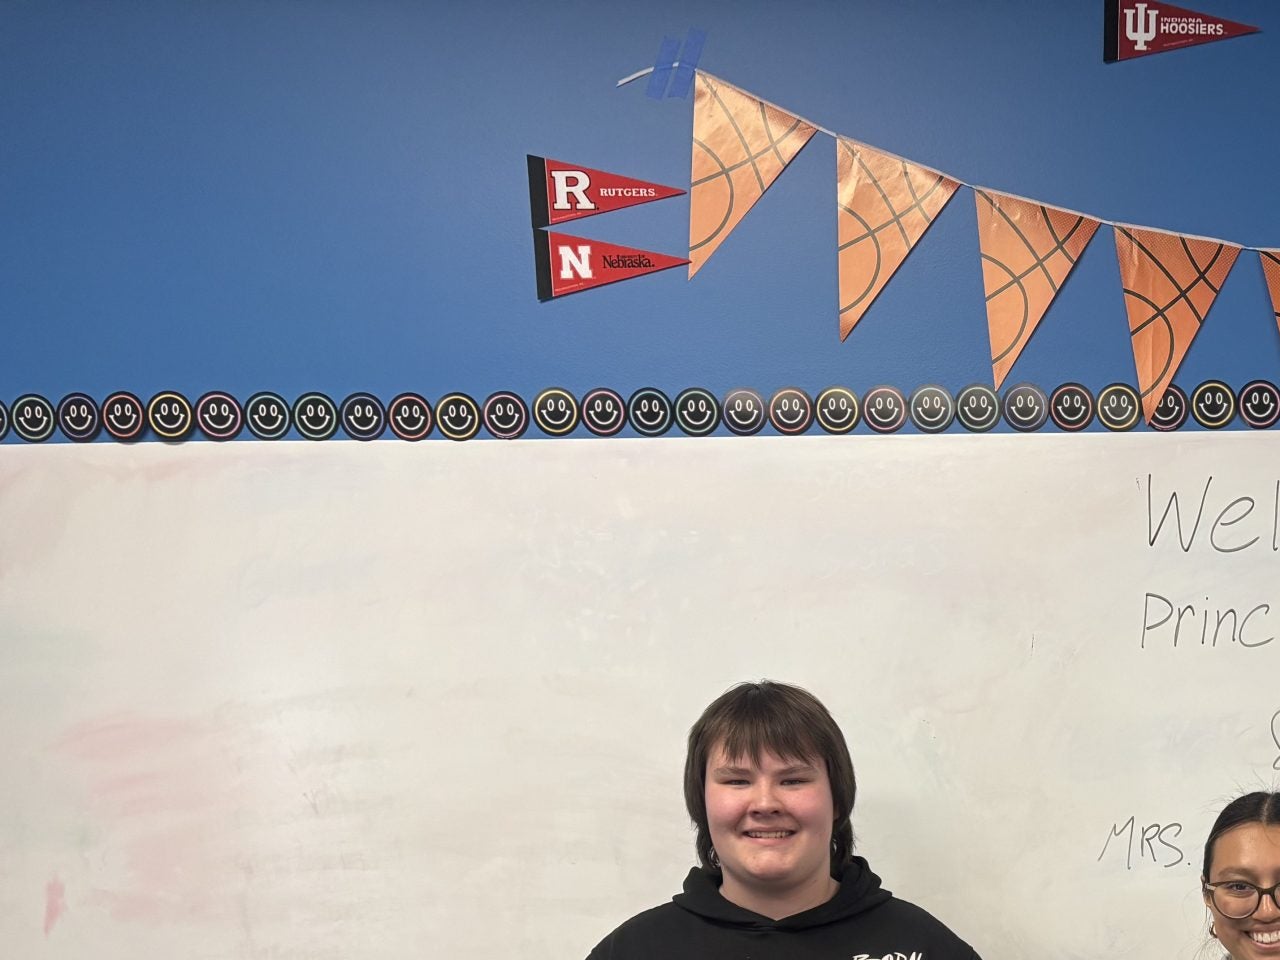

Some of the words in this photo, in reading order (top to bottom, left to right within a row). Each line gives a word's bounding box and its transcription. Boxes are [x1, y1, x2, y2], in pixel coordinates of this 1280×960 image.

[1160, 23, 1224, 35] HOOSIERS
[551, 170, 596, 210] R
[600, 188, 656, 197] RUTGERS
[558, 245, 594, 280] N
[602, 254, 651, 268] Nebraska
